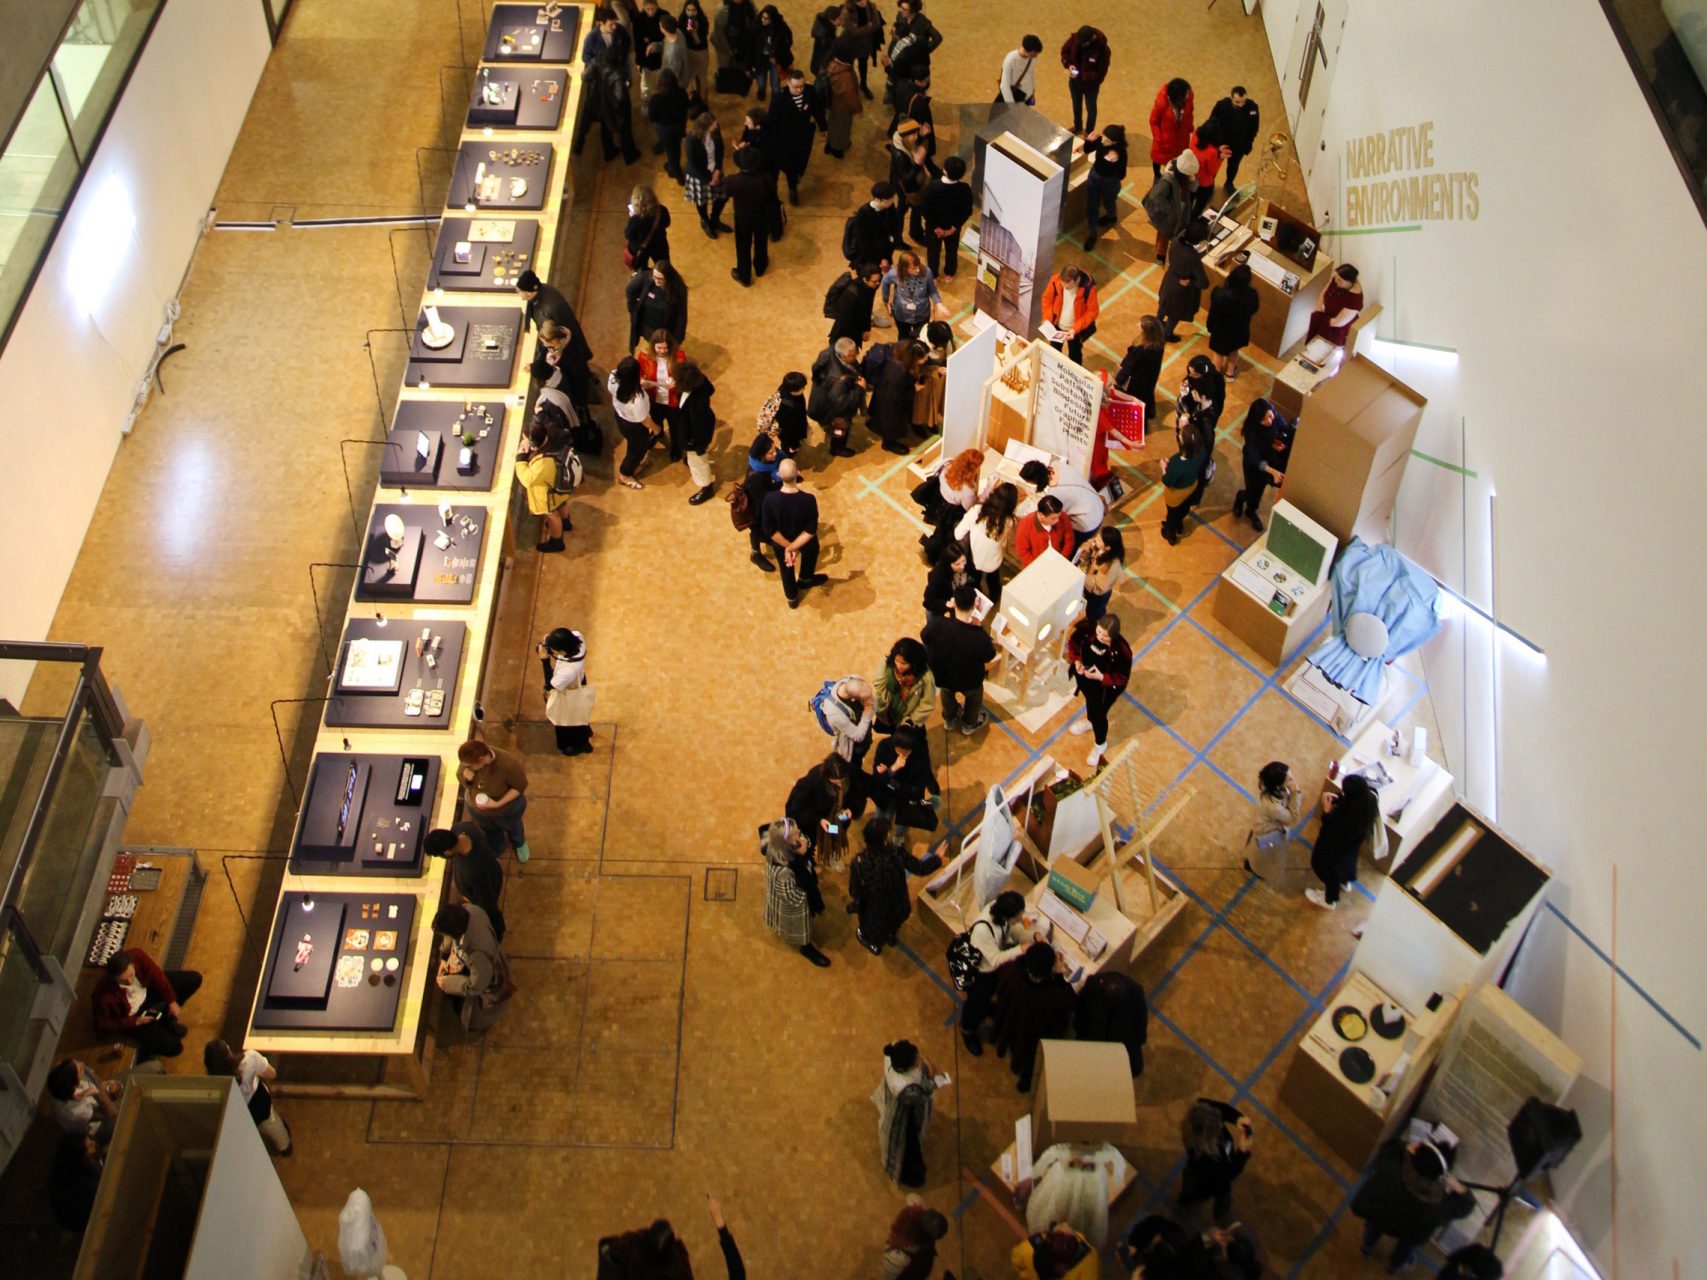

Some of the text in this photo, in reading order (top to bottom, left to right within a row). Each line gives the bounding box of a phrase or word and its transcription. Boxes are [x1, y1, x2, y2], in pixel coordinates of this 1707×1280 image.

[1347, 121, 1434, 179] NARRATIVE
[1346, 172, 1479, 226] ENVIRONMENTS
[1057, 363, 1094, 391] Molecular
